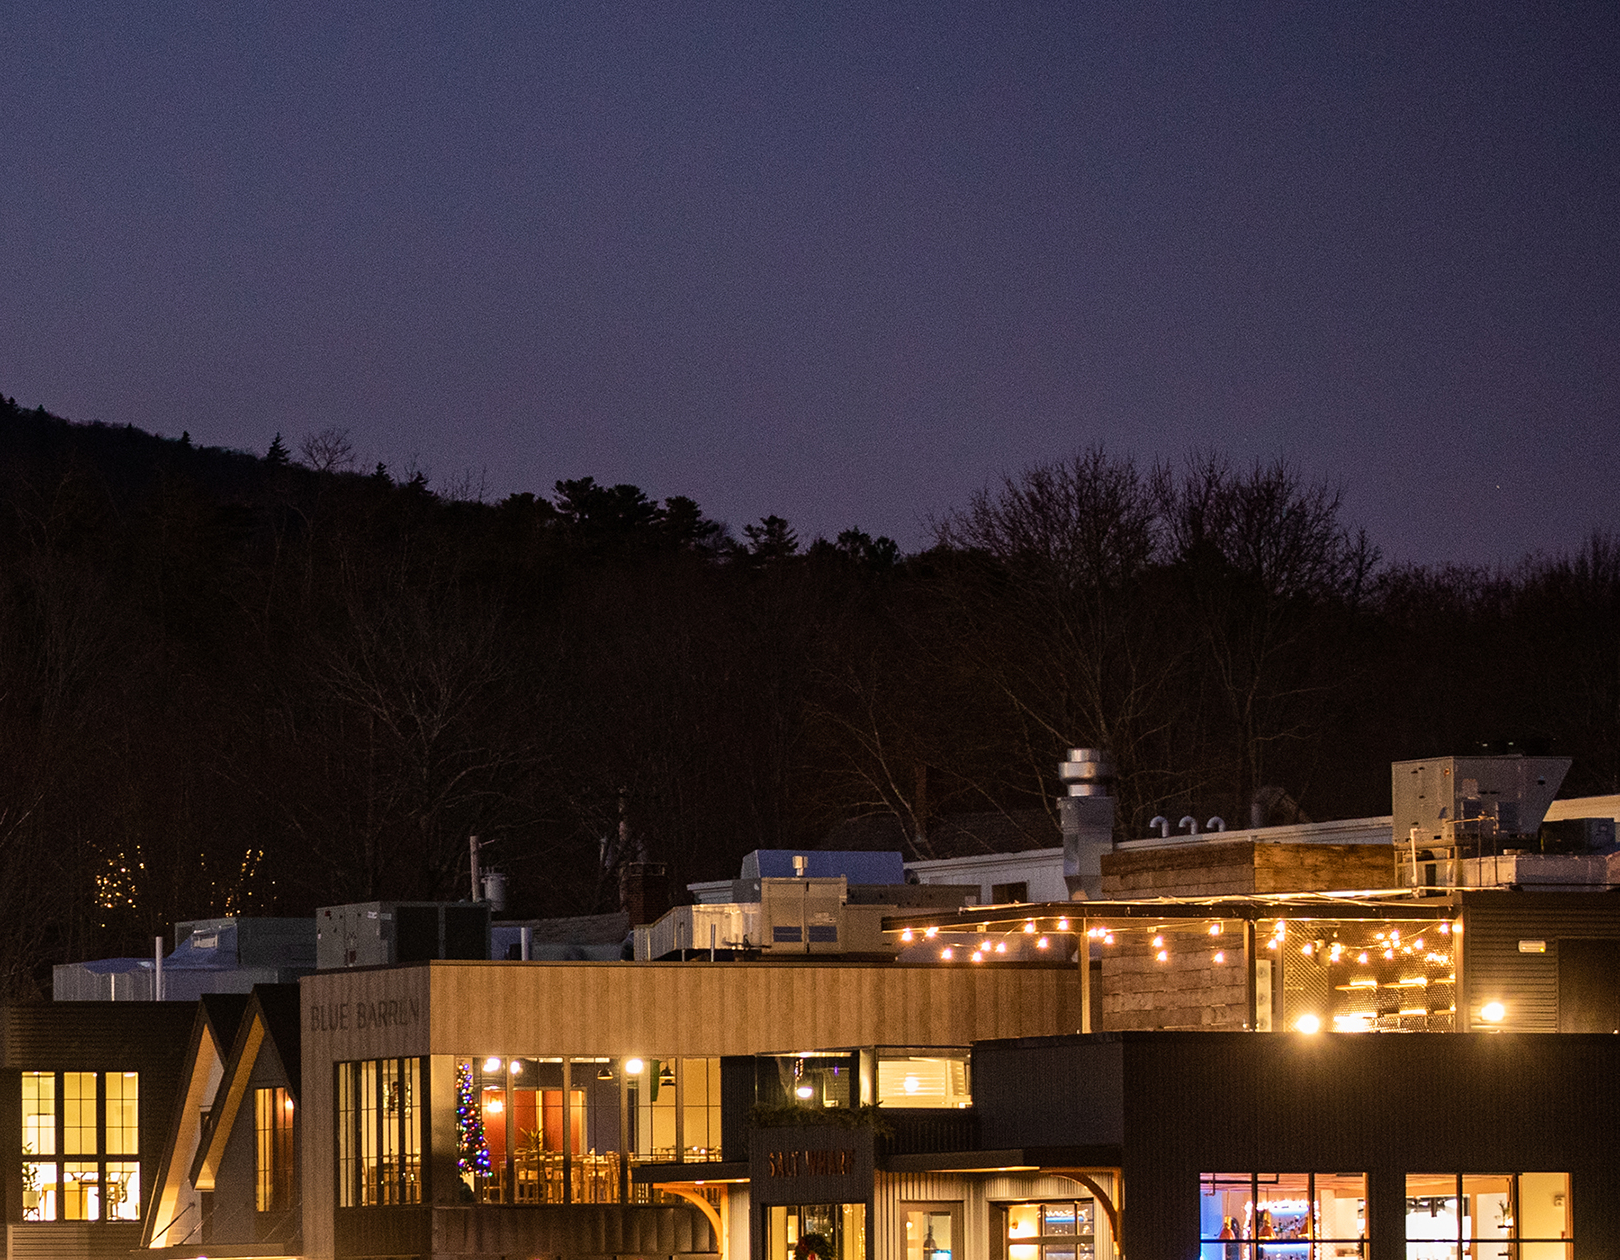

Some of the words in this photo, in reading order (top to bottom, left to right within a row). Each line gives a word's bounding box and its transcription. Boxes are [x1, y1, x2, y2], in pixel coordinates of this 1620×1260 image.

[310, 1004, 349, 1031] BLUE
[356, 998, 419, 1029] BARREN
[769, 1151, 801, 1177] SALT
[805, 1149, 855, 1175] WHARF
